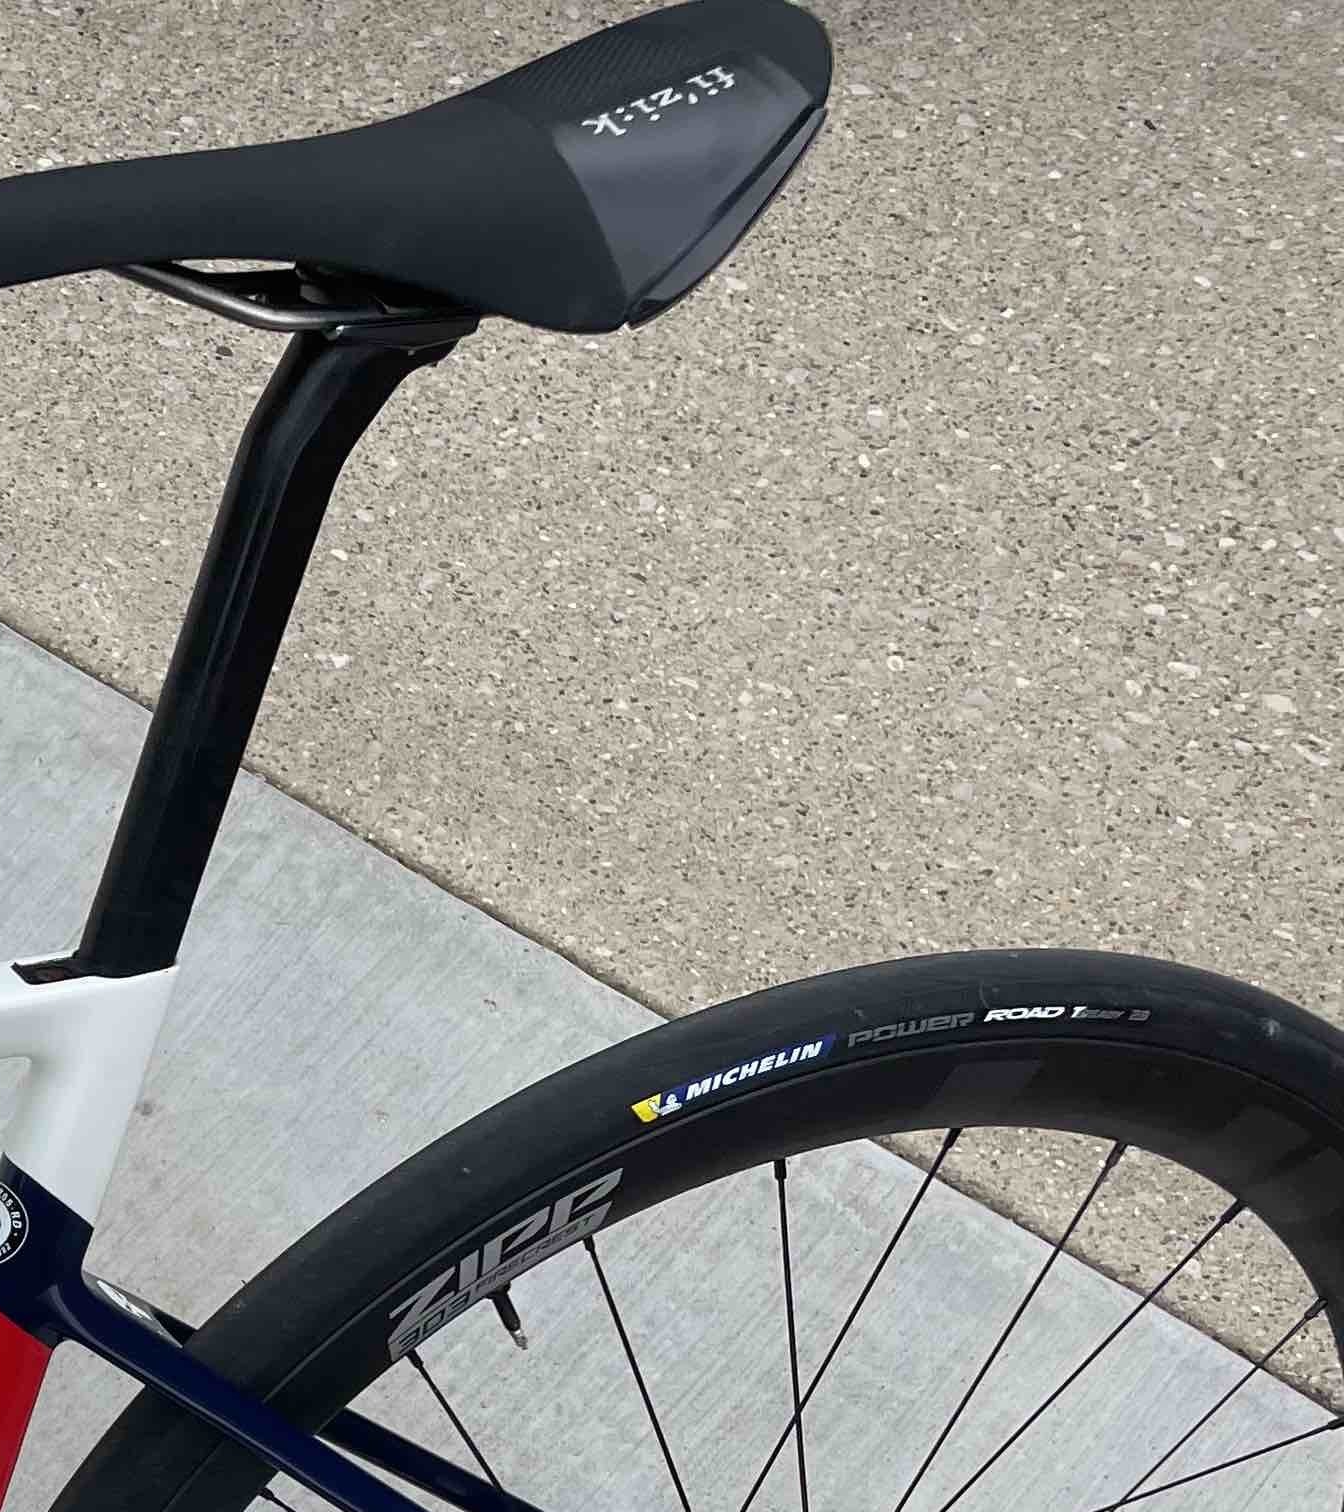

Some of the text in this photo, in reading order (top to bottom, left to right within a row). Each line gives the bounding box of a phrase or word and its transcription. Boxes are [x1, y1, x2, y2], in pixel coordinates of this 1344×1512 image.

[686, 1040, 823, 1100] MICHELIN
[847, 1011, 976, 1048] POWER
[983, 1005, 1064, 1023] ROAD
[387, 1167, 624, 1346] ZIPP
[397, 1290, 472, 1356] 303
